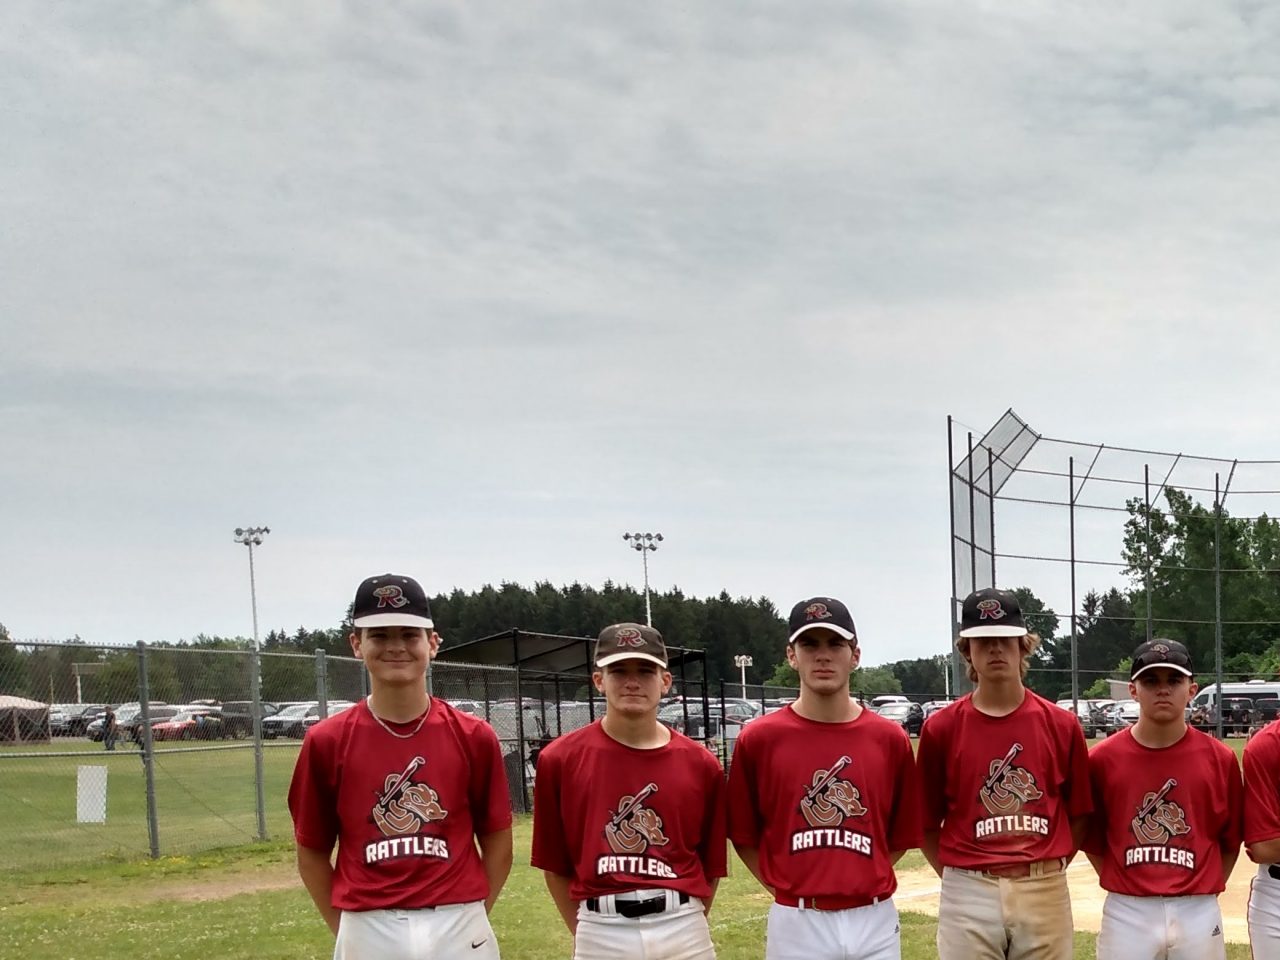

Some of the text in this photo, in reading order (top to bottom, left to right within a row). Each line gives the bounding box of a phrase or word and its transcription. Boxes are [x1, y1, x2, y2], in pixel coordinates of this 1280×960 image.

[976, 816, 1048, 837] RATTLERS
[366, 836, 449, 863] RATTLERS
[792, 829, 871, 855] RATTLERS
[597, 855, 678, 879] RATTLERS
[1126, 846, 1194, 869] RATTLERS
